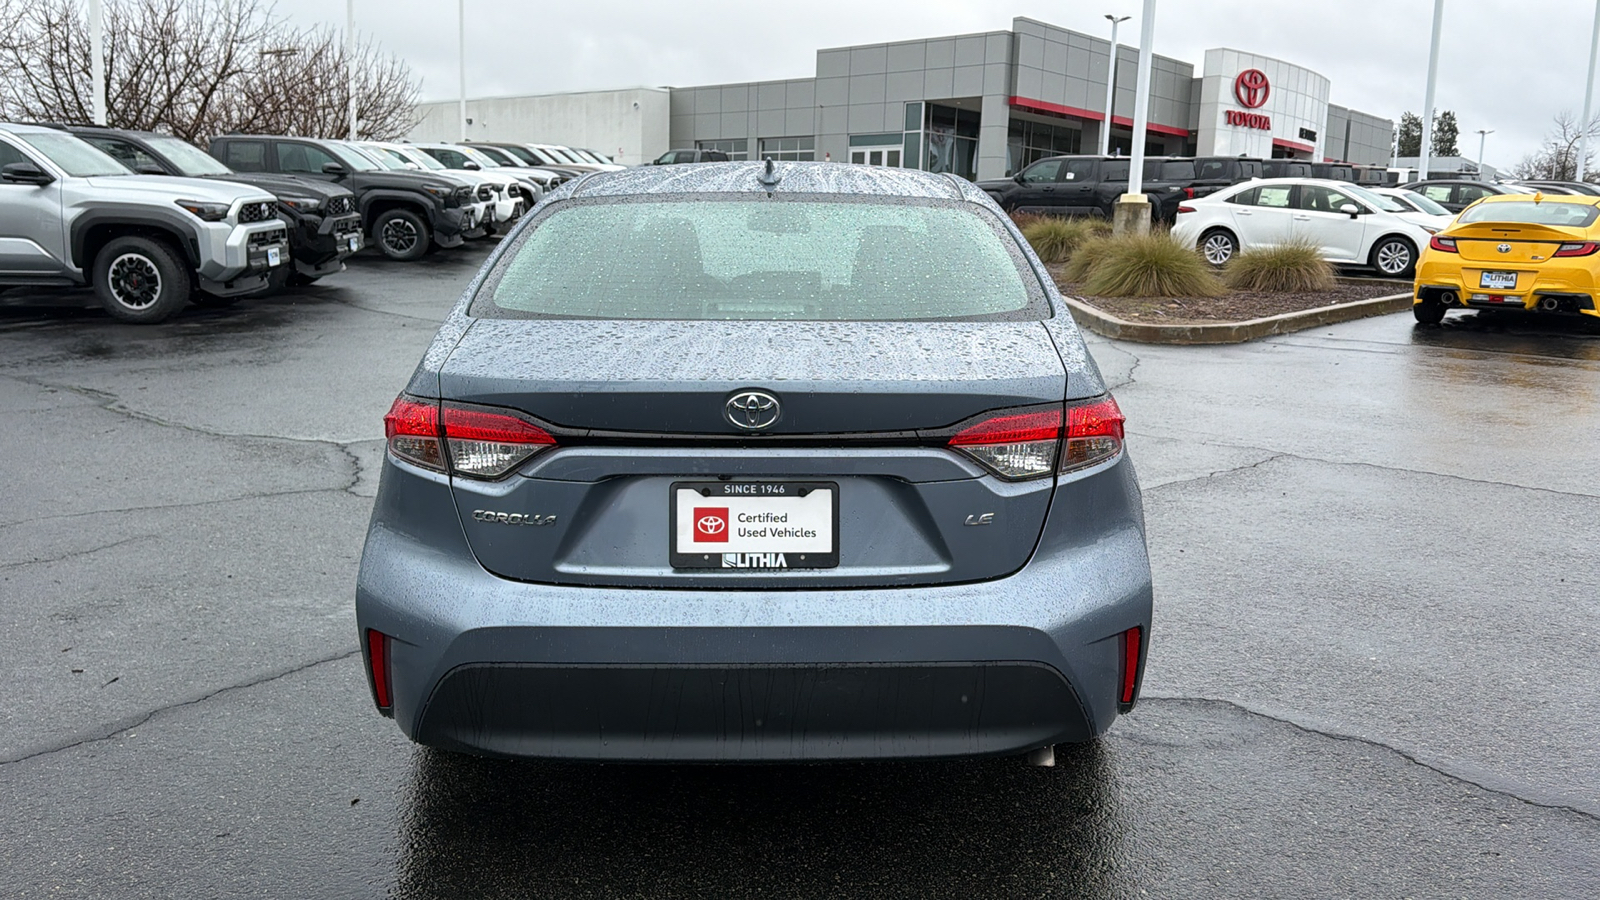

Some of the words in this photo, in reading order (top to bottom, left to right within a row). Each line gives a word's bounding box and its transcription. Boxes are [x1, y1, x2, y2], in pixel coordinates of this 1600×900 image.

[1226, 110, 1271, 130] TOYOTA
[1490, 274, 1515, 282] LITHIA
[724, 484, 757, 494] SINCE
[760, 484, 785, 494] 1946
[472, 509, 557, 526] COROLLA
[737, 512, 788, 523] Certified
[964, 512, 995, 526] LE
[737, 527, 767, 538] Used
[770, 527, 817, 538] Vehicles
[737, 553, 788, 568] LITHIA
